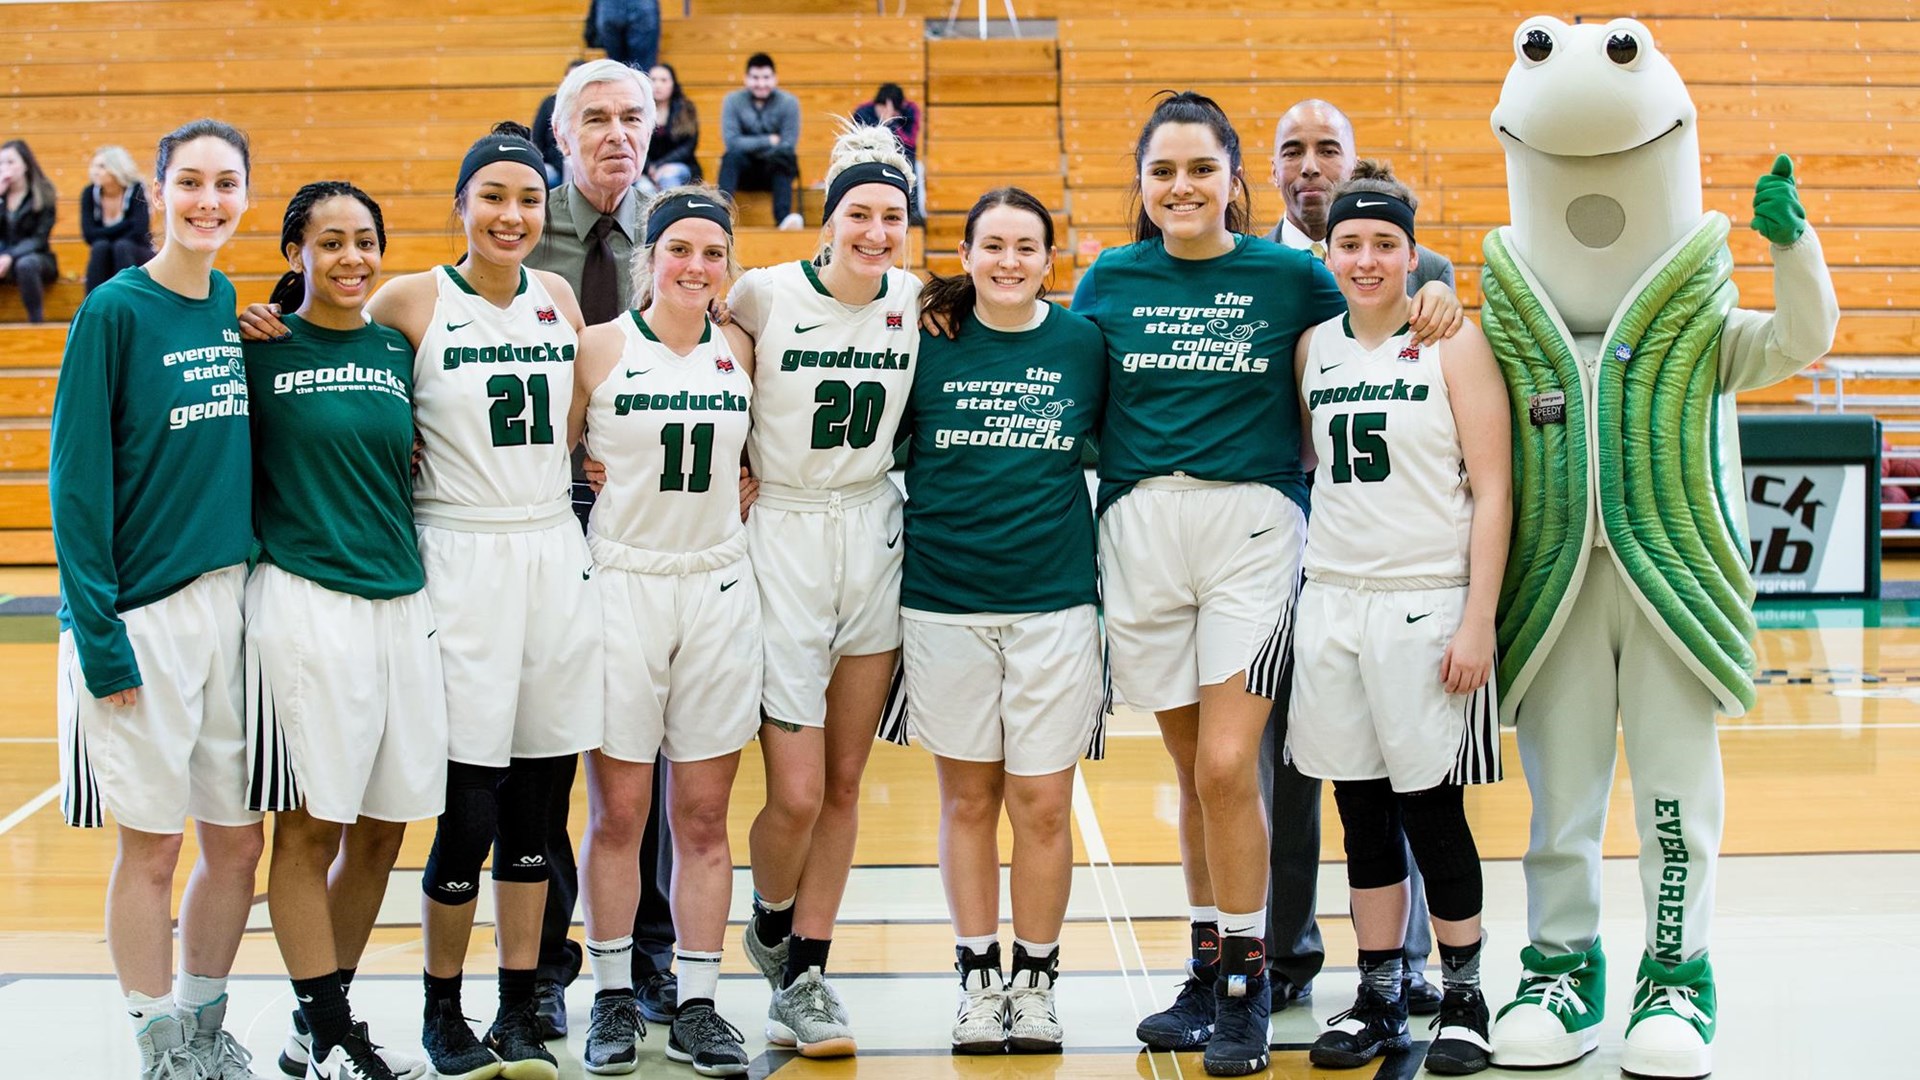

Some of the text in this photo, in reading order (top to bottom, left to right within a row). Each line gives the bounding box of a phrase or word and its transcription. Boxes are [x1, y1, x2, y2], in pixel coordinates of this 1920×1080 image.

[1214, 292, 1254, 306] the
[1132, 304, 1245, 320] evergreen
[1143, 321, 1206, 335] state
[163, 345, 243, 367] evergreen
[442, 342, 575, 370] geoducks
[1171, 338, 1253, 355] college
[780, 346, 910, 371] geoducks
[1122, 351, 1270, 374] geoducks
[183, 363, 230, 382] state
[274, 363, 407, 394] geoducks
[1026, 367, 1062, 384] the
[211, 380, 248, 399] colle
[296, 386, 314, 394] the
[316, 384, 366, 392] evergreen
[368, 384, 390, 394] state
[942, 379, 1055, 397] evergreen
[1309, 378, 1429, 411] geoducks
[486, 373, 554, 447] 21
[810, 380, 886, 450] 20
[955, 397, 1017, 411] state
[1532, 405, 1562, 418] SPEEDY
[984, 414, 1063, 433] college
[935, 427, 1075, 451] geoducks
[1328, 412, 1391, 484] 15
[659, 423, 715, 493] 11
[1744, 475, 1826, 533] ck
[1655, 798, 1689, 962] EVERGREEN
